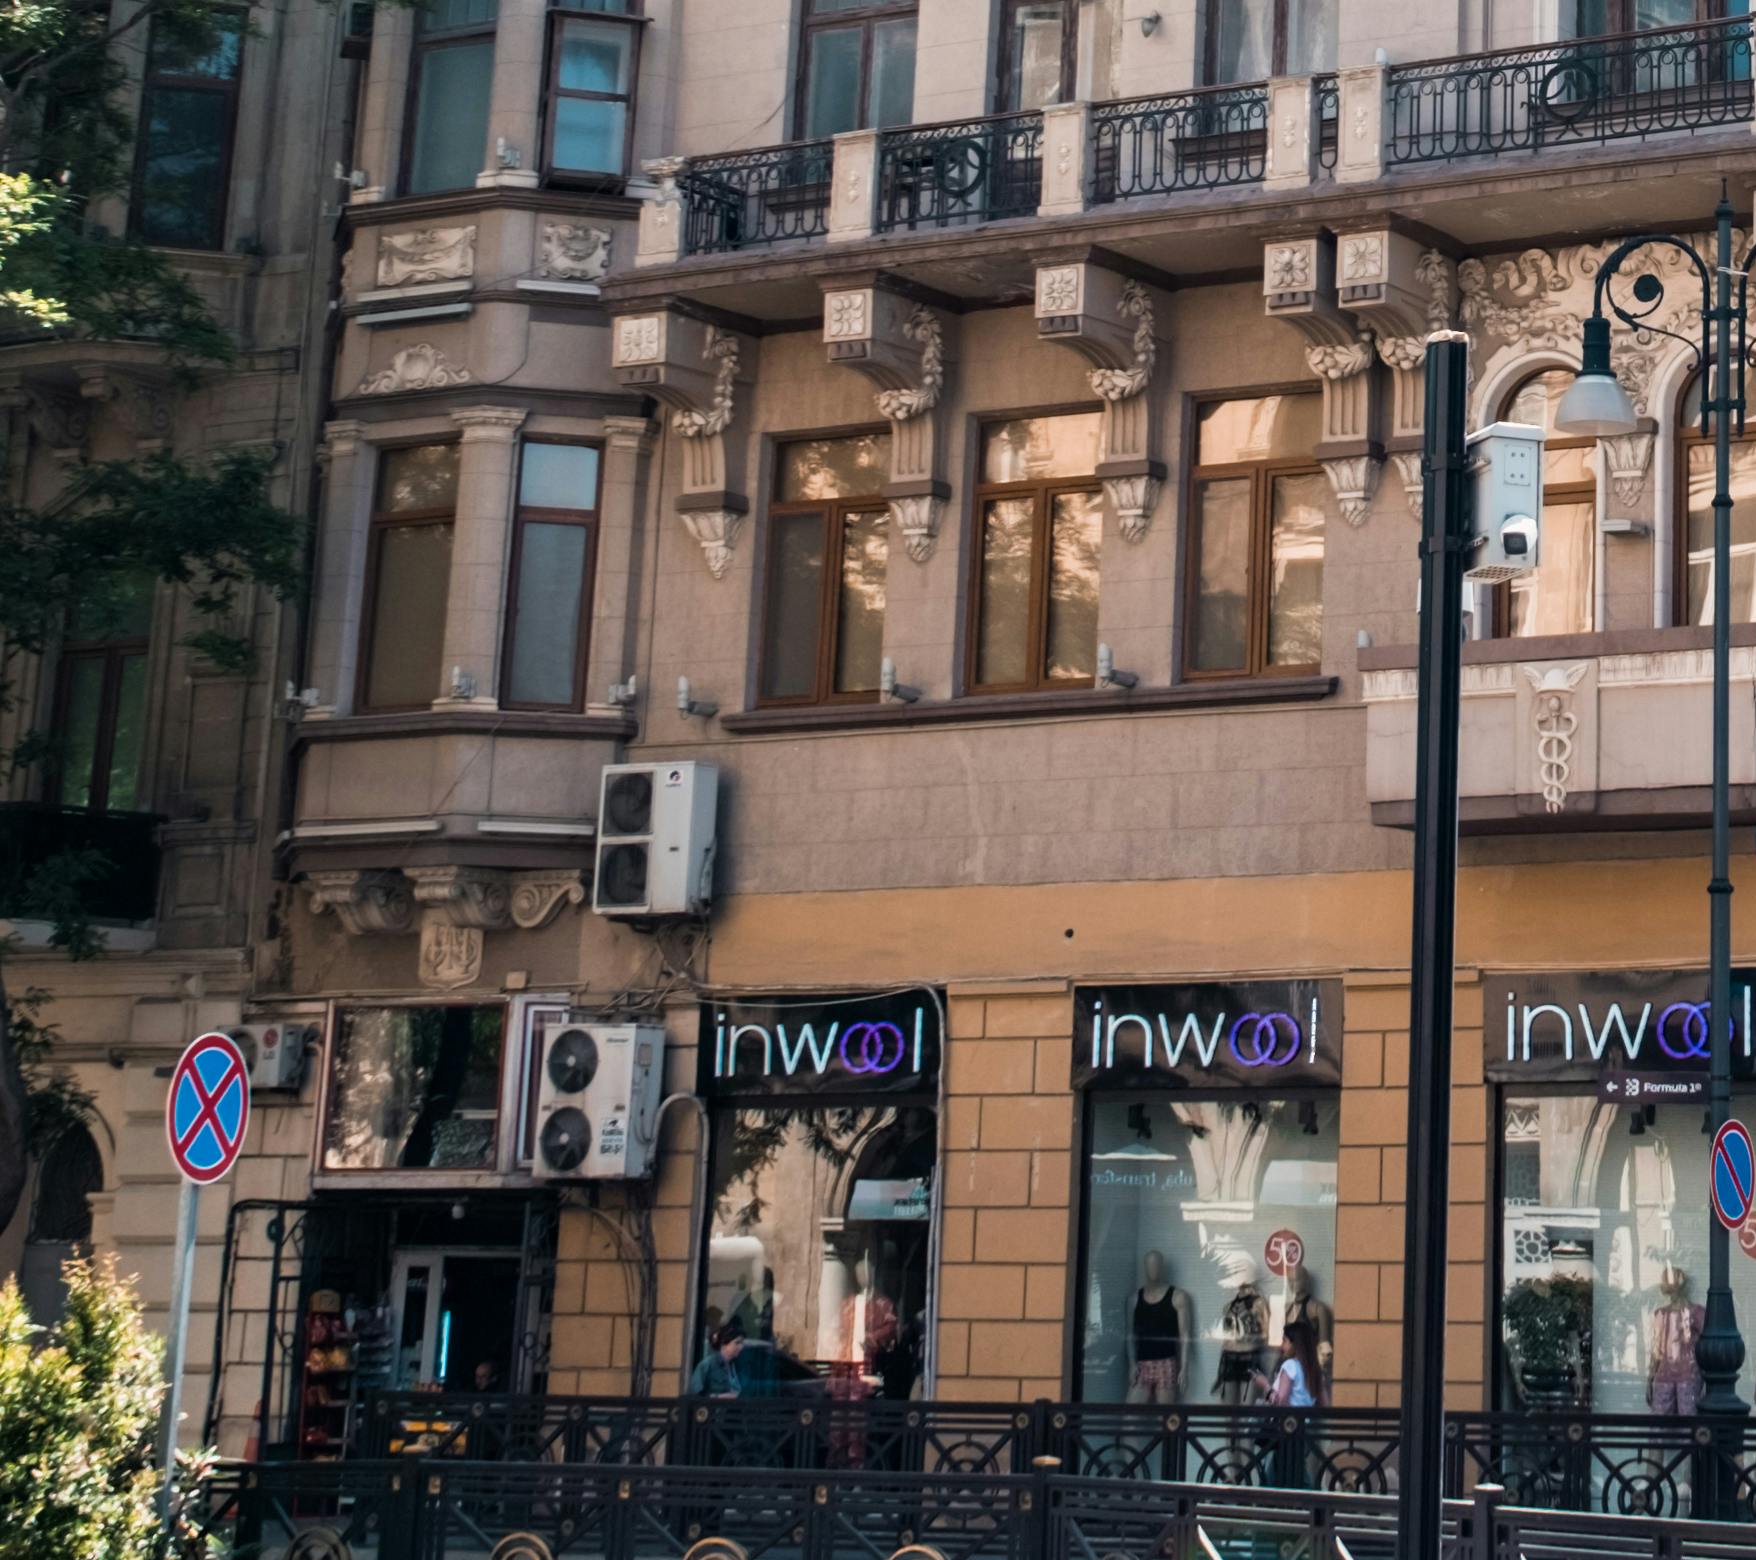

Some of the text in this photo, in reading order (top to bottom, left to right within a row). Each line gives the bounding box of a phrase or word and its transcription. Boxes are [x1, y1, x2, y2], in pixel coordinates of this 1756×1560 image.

[715, 1007, 923, 1077] inwool
[1092, 997, 1317, 1068] inwool
[1643, 1083, 1688, 1093] Formula
